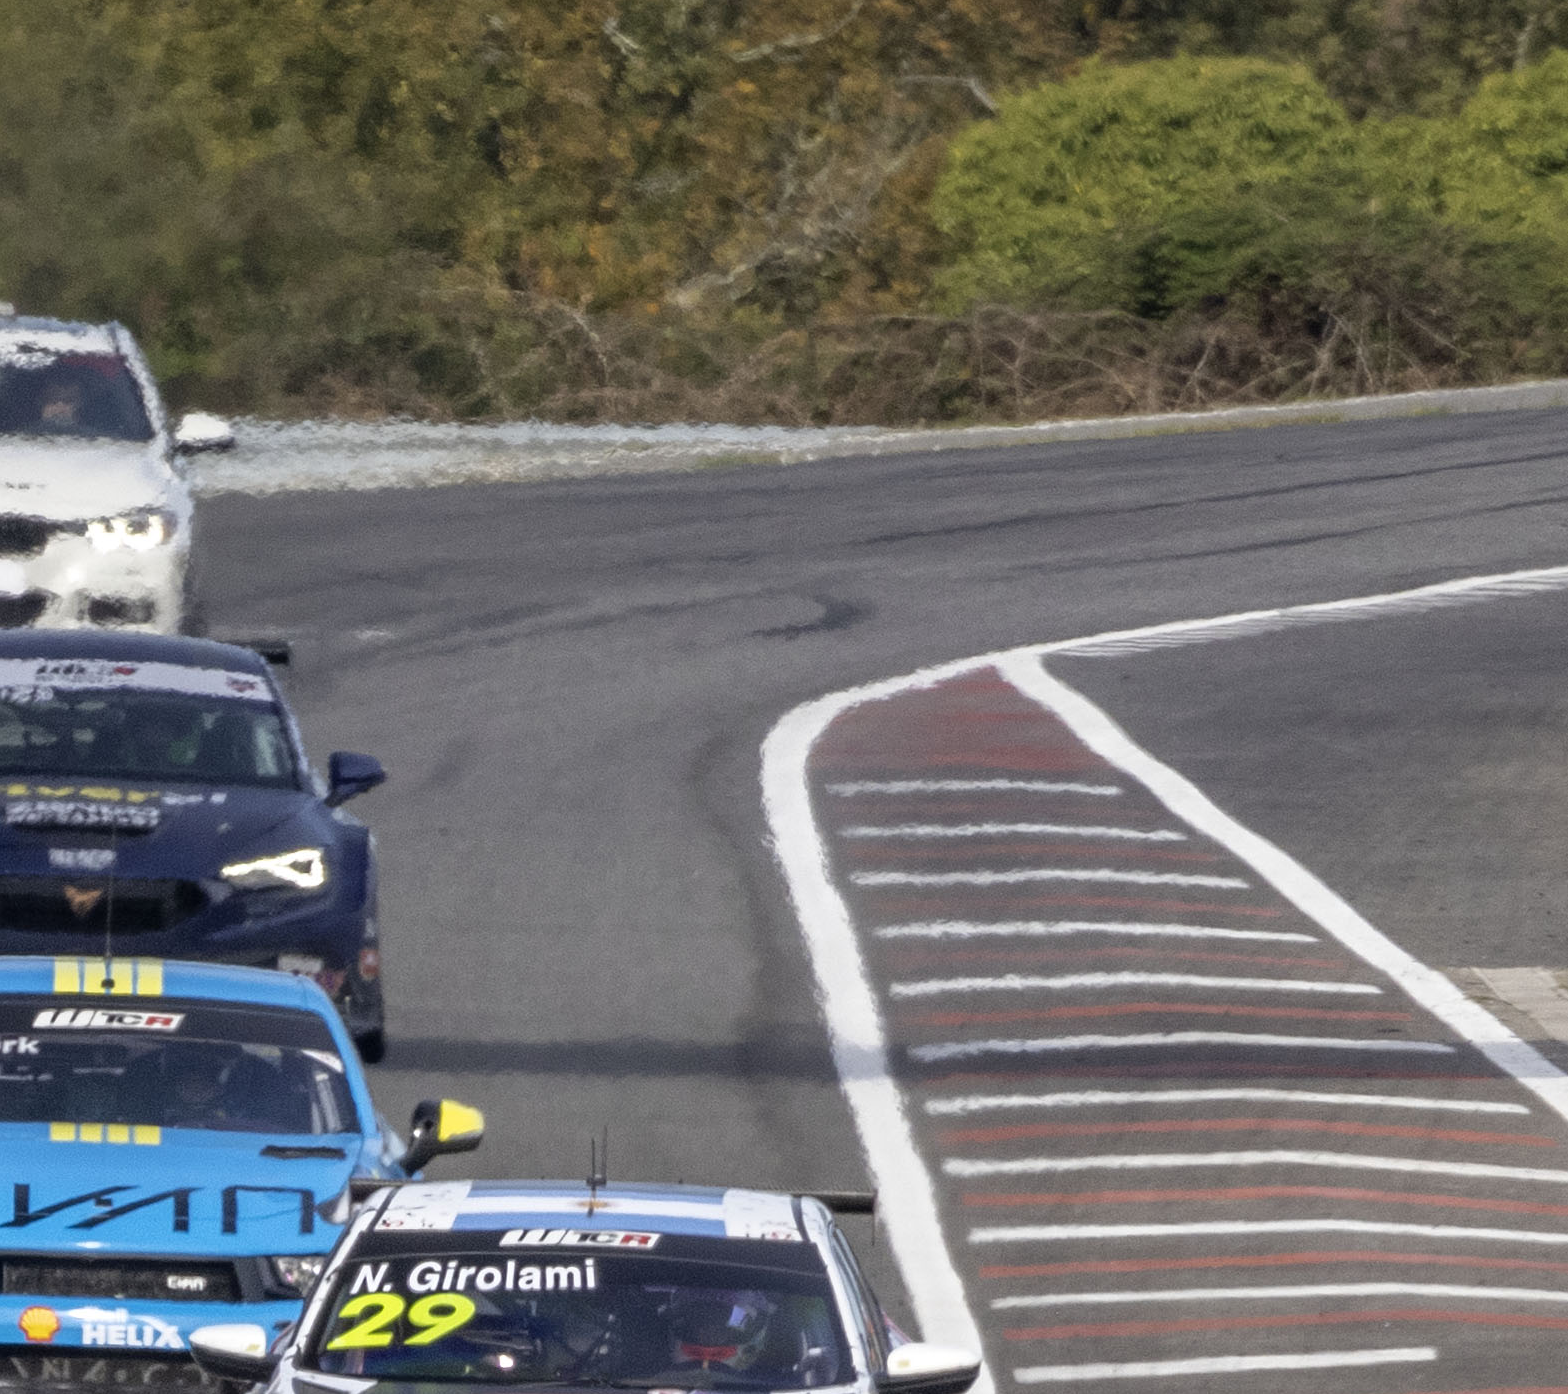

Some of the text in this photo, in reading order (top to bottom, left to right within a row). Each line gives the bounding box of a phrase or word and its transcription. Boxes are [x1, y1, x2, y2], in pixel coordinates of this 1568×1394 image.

[32, 1007, 186, 1032] WTCR
[498, 1228, 662, 1251] WTCR
[350, 1258, 596, 1295] N. Girolami
[326, 1291, 476, 1351] 29
[80, 1323, 185, 1349] HELIX
